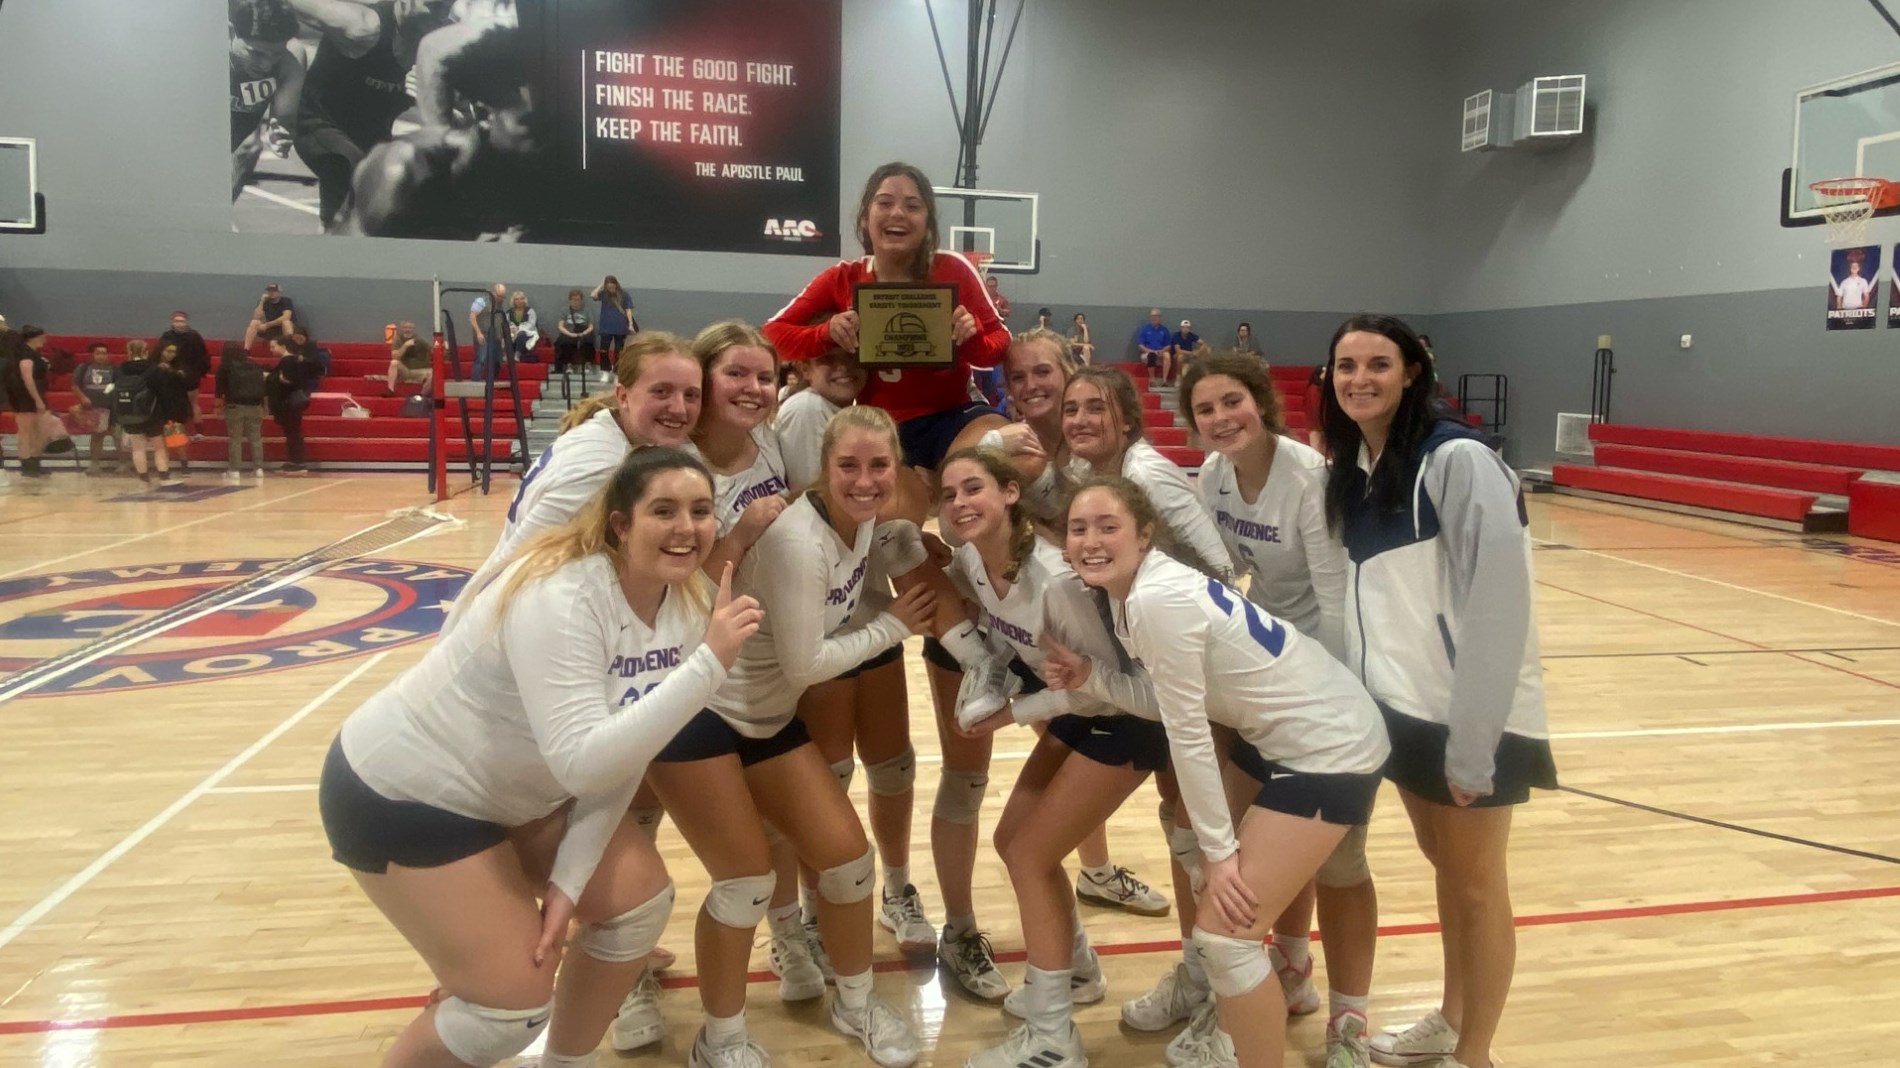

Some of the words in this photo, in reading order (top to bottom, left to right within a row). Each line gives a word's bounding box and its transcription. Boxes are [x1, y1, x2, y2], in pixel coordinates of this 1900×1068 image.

[596, 51, 645, 75] FIGHT
[652, 55, 684, 78] THE
[693, 59, 738, 82] GOOD
[746, 62, 797, 86] FIGHT.
[244, 80, 273, 104] 10
[596, 84, 654, 108] FINISH
[662, 89, 693, 111] THE
[703, 92, 752, 115] RACE.
[596, 117, 641, 140] KEEP
[650, 120, 681, 143] THE
[690, 123, 743, 147] FAITH.
[695, 162, 716, 177] THE
[722, 163, 772, 181] APOSTLE
[776, 166, 804, 182] PAUL
[1828, 308, 1876, 319] PATRIOTS
[47, 561, 465, 587] ACAEMY
